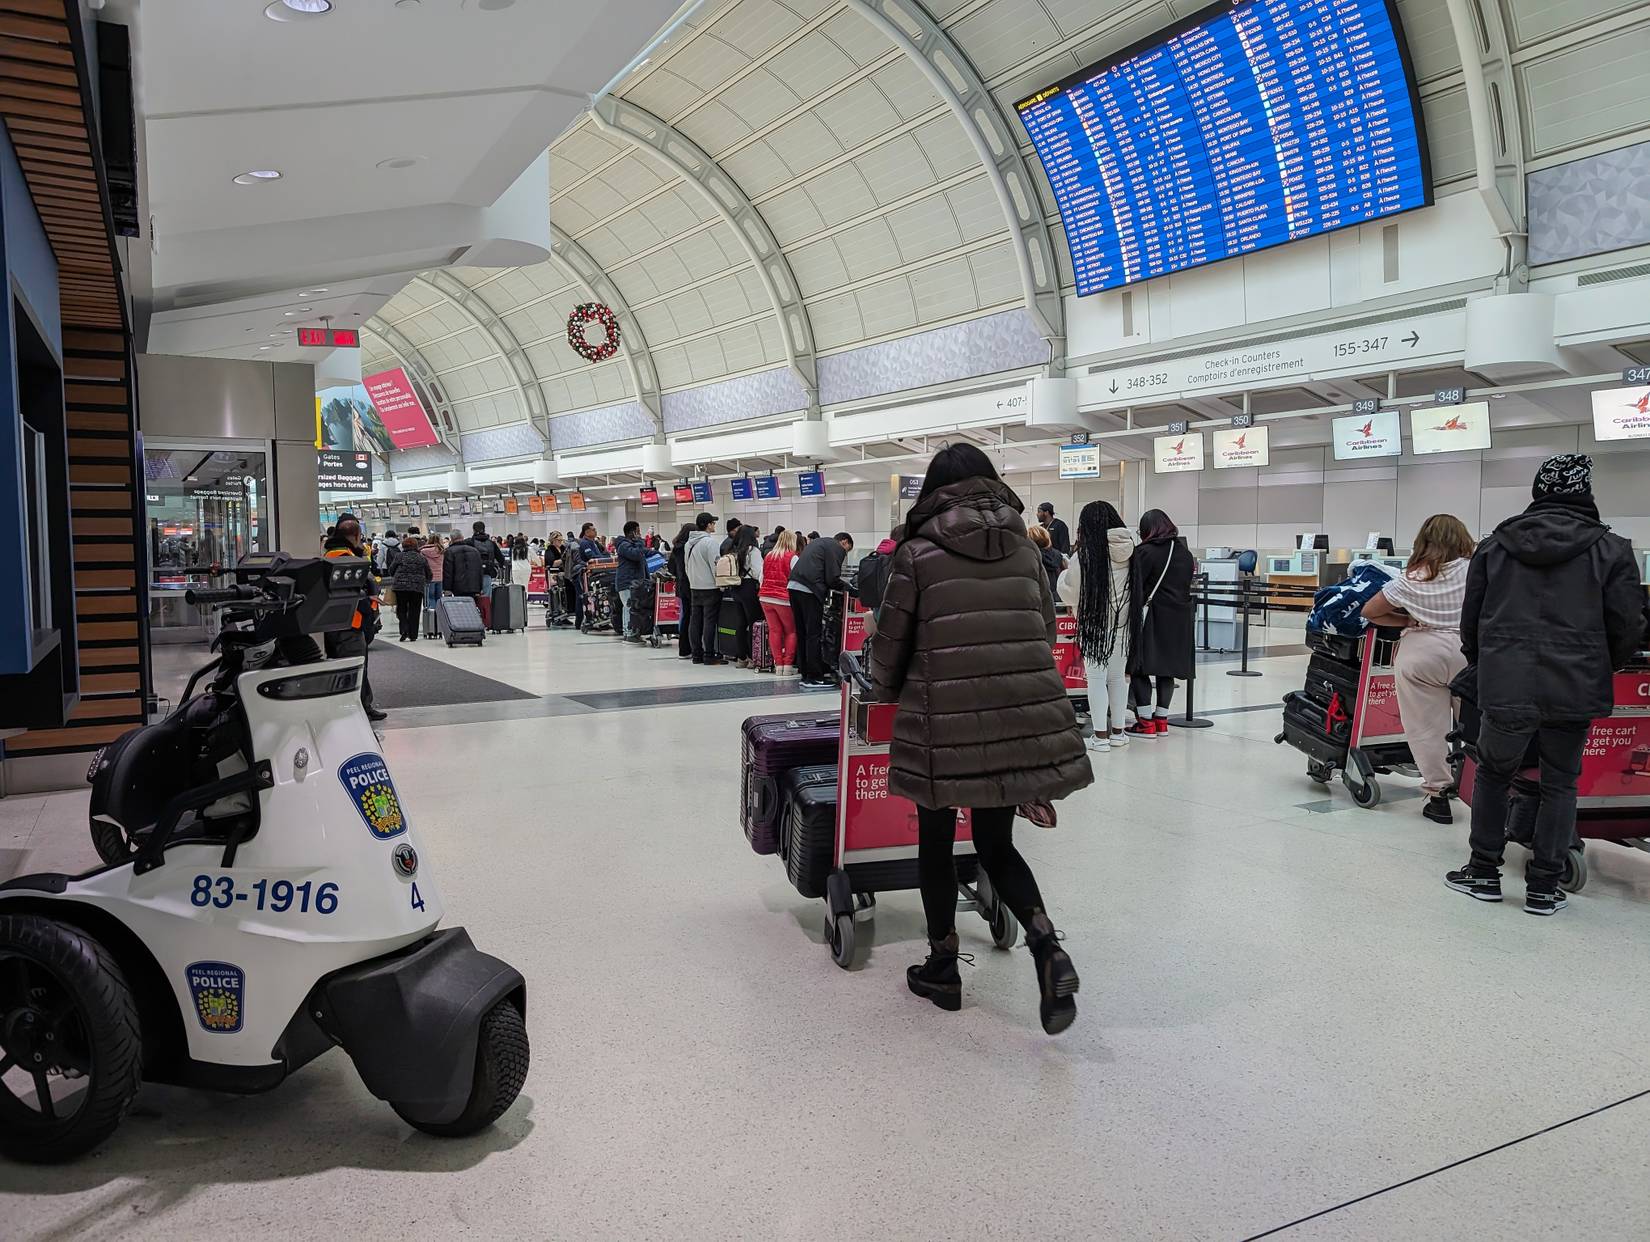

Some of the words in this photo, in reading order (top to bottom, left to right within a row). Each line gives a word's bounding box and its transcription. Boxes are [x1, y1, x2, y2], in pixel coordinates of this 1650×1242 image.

[1211, 53, 1222, 61] CITY
[1236, 199, 1255, 209] CALGARY
[1255, 204, 1268, 212] PLATA
[1334, 337, 1388, 357] 155-347
[1205, 357, 1239, 370] Check-in
[1242, 351, 1280, 363] Counters
[1188, 371, 1227, 384] Comptoirs
[1230, 358, 1304, 377] d'enregistrement
[1628, 370, 1650, 382] 347
[1127, 373, 1168, 389] 348-352
[1438, 390, 1459, 402] 348
[1356, 400, 1374, 412] 349
[1234, 416, 1248, 426] 350
[1613, 416, 1650, 424] Caribb
[1170, 423, 1183, 432] 351
[1073, 434, 1084, 443] 352
[1346, 438, 1387, 446] Caribbean
[1377, 690, 1388, 698] get
[1592, 726, 1613, 735] free
[1616, 726, 1636, 735] cart
[1593, 737, 1610, 747] get
[1612, 738, 1631, 747] you
[346, 767, 360, 775] PEEL
[361, 761, 384, 770] REGIONAL
[856, 765, 865, 776] A
[349, 769, 389, 789] POLICE
[856, 778, 868, 788] to
[856, 788, 887, 800] there
[191, 874, 339, 914] 83-1916
[412, 882, 425, 912] 4
[192, 976, 239, 988] POLICE
